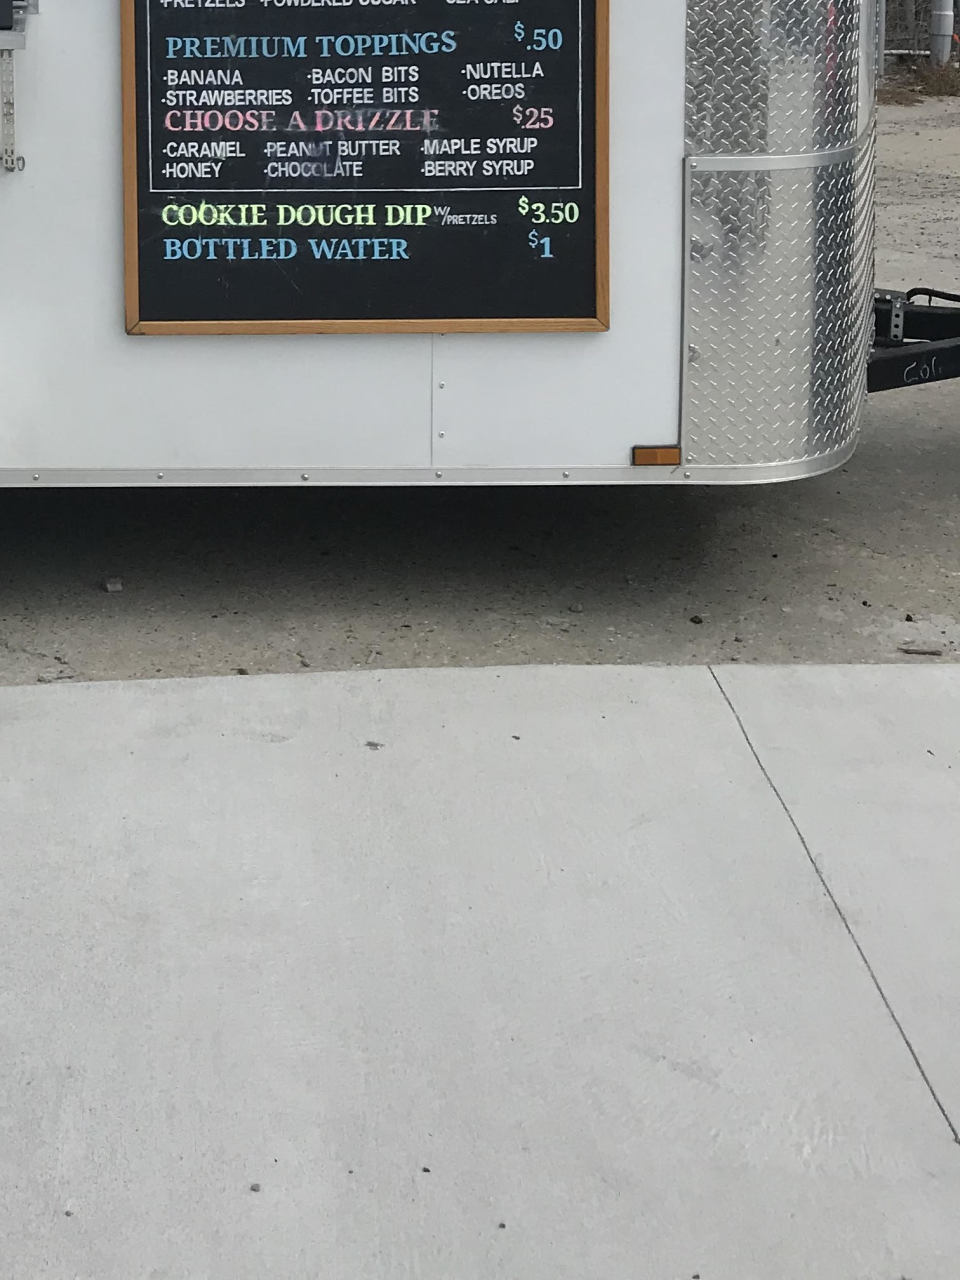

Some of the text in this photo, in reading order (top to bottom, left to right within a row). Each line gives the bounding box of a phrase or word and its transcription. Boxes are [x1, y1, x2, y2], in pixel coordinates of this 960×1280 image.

[166, 21, 563, 58] PREMIUM TOPPINGS $.50
[167, 70, 244, 85] BANANA
[312, 66, 419, 84] BACON BITS
[466, 62, 544, 79] NUTELLA
[166, 89, 293, 106] STRAWBERRIES
[311, 87, 419, 104] TOFFEE BITS
[467, 83, 525, 100] OREOS
[165, 104, 554, 132] CHOOSE A DRIZZLE $.25
[166, 142, 246, 158] CARAMEL
[338, 140, 400, 156] BUTTER
[424, 138, 538, 154] MAPLE SYRUP
[166, 162, 223, 178] HONEY
[267, 161, 363, 177] CHOCOLATE
[425, 160, 534, 176] BERRY SYRUP
[162, 202, 267, 226] COOKIE
[277, 204, 380, 225] DOUGH
[385, 205, 432, 226] DIP
[518, 195, 579, 224] $3.50
[163, 229, 554, 260] BOTTLED WATER $1
